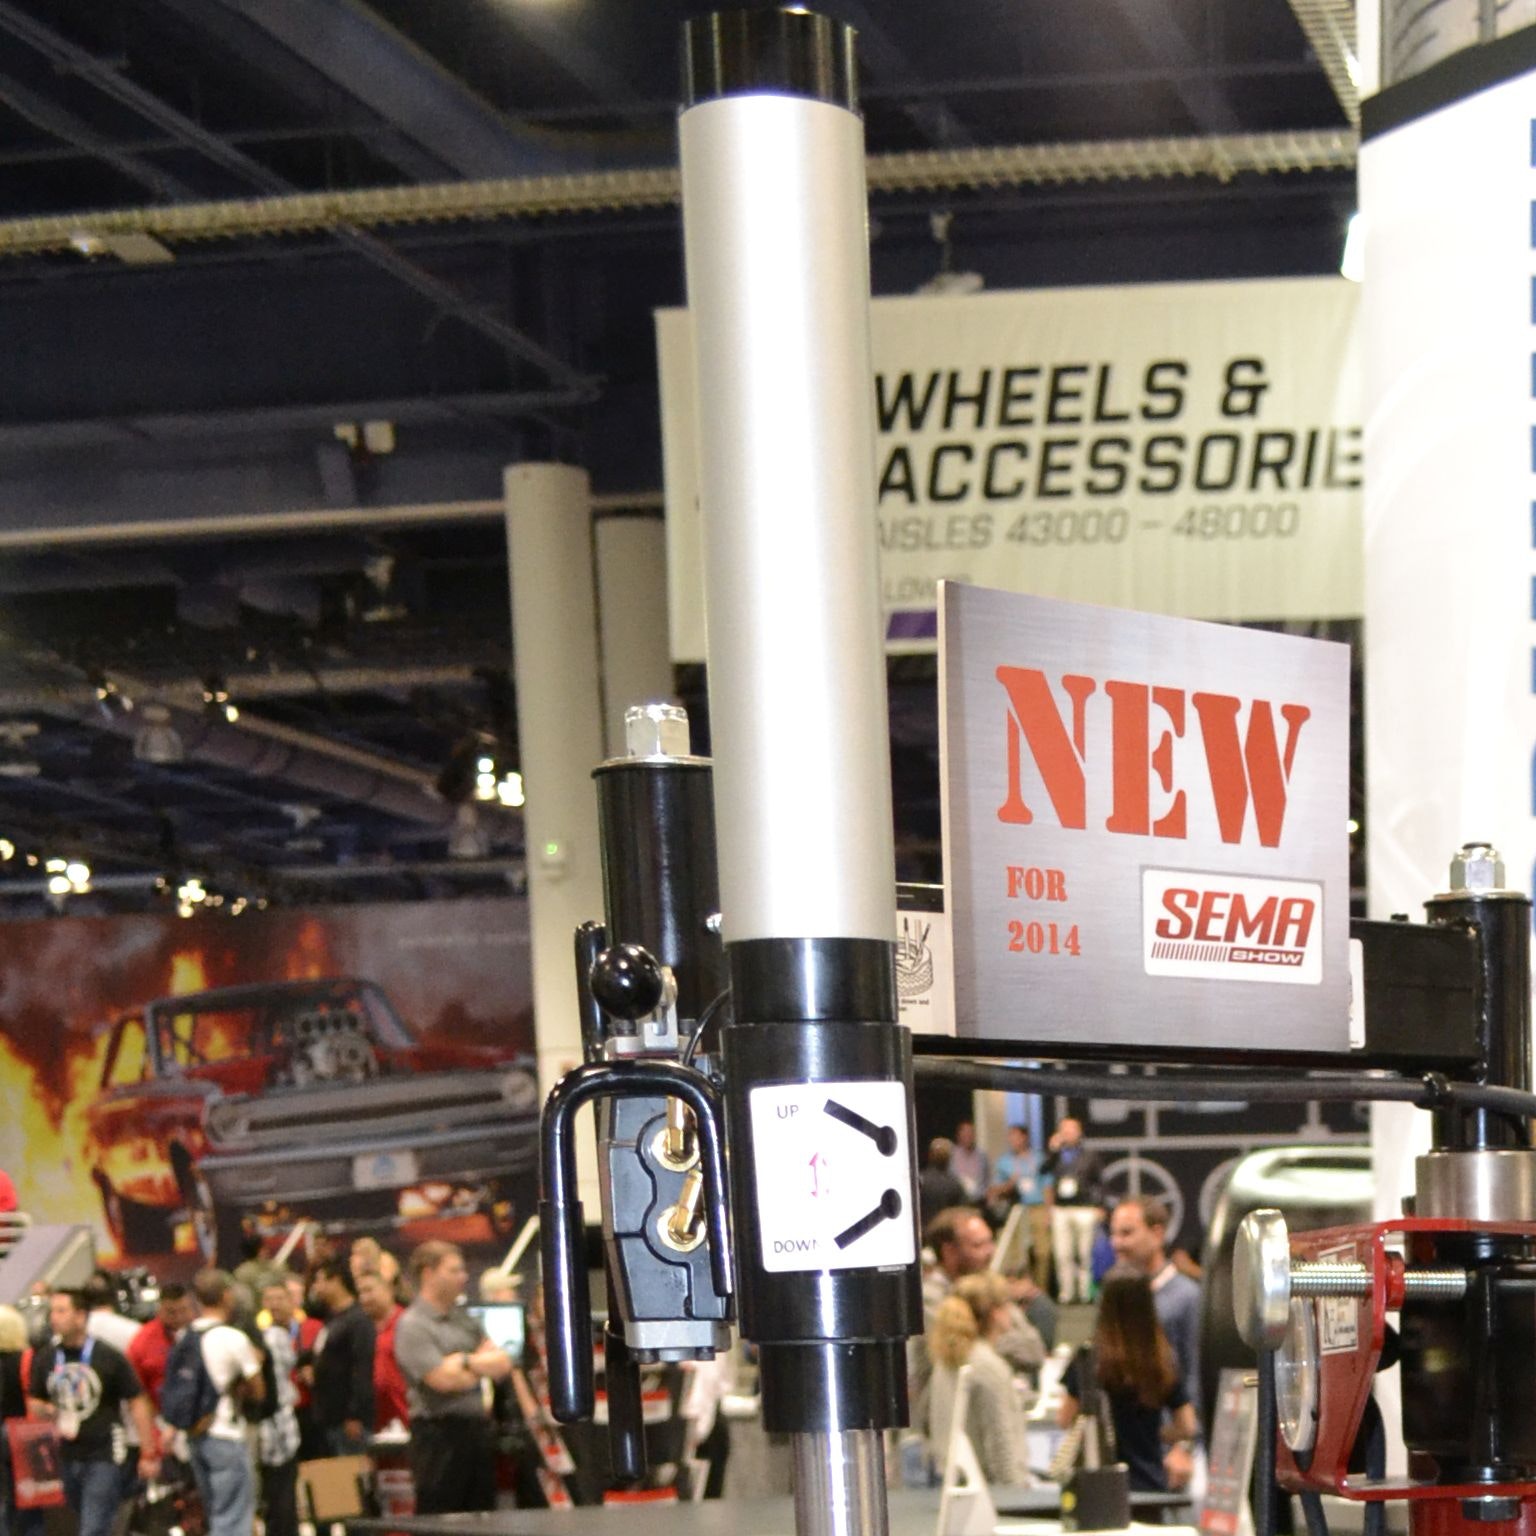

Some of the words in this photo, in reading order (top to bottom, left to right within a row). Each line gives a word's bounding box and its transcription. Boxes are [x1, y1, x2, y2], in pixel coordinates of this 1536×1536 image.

[876, 359, 1189, 433] WHEELS
[1222, 358, 1270, 419] &
[877, 427, 1363, 504] ACCESSORIE
[997, 665, 1311, 848] NEW
[1007, 866, 1068, 902] FOR
[1008, 920, 1081, 956] 2014
[1155, 888, 1315, 948] SEMA
[1231, 950, 1303, 965] SHOW
[777, 1105, 799, 1119] UP
